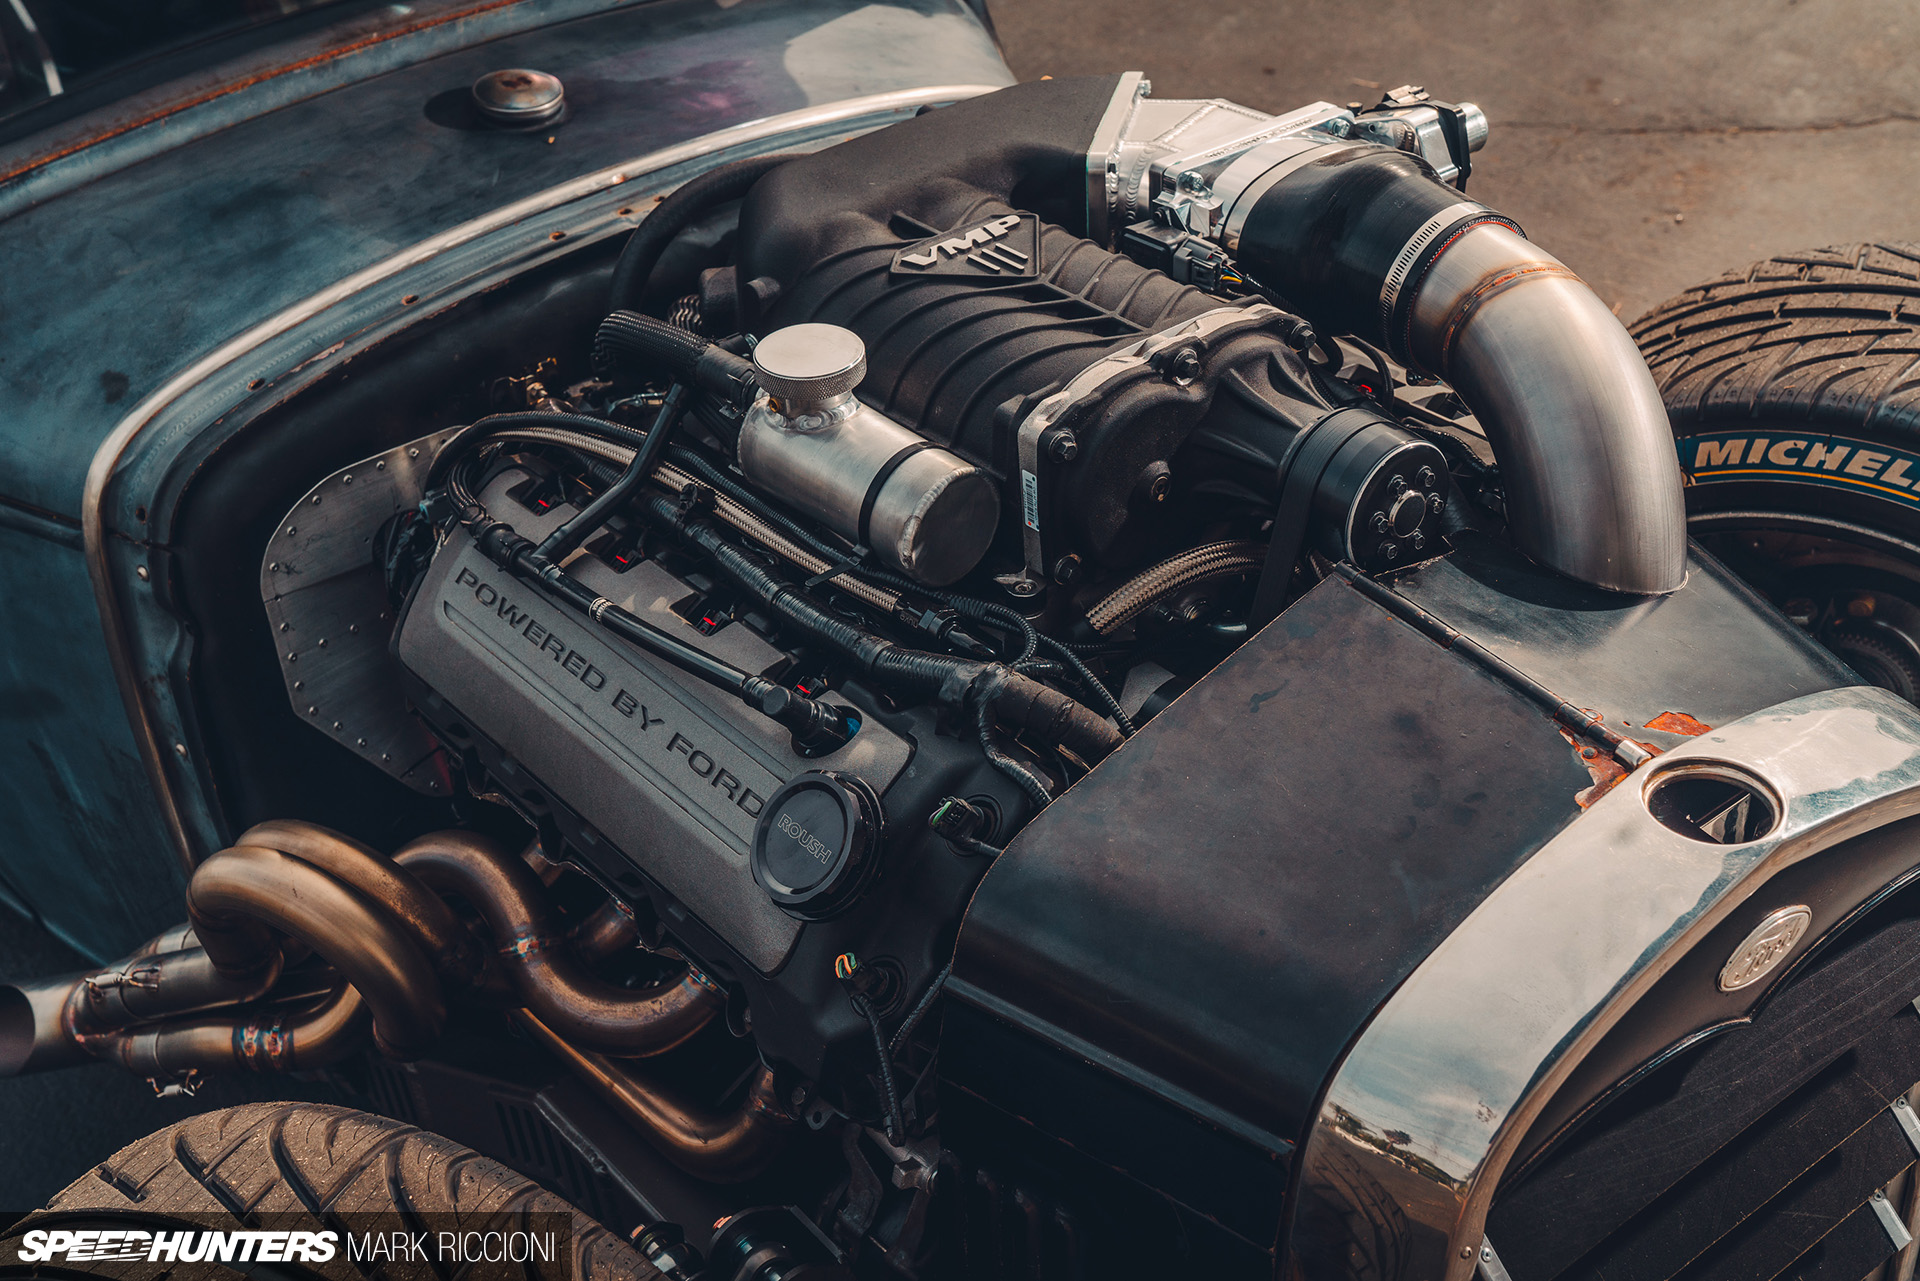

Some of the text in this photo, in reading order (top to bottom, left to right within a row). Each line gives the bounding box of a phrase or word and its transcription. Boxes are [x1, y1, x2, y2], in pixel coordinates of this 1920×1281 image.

[901, 214, 1021, 269] VMP
[454, 566, 765, 819] POWERED BY FORD
[777, 813, 833, 865] ROUSH
[1732, 916, 1802, 985] Ford
